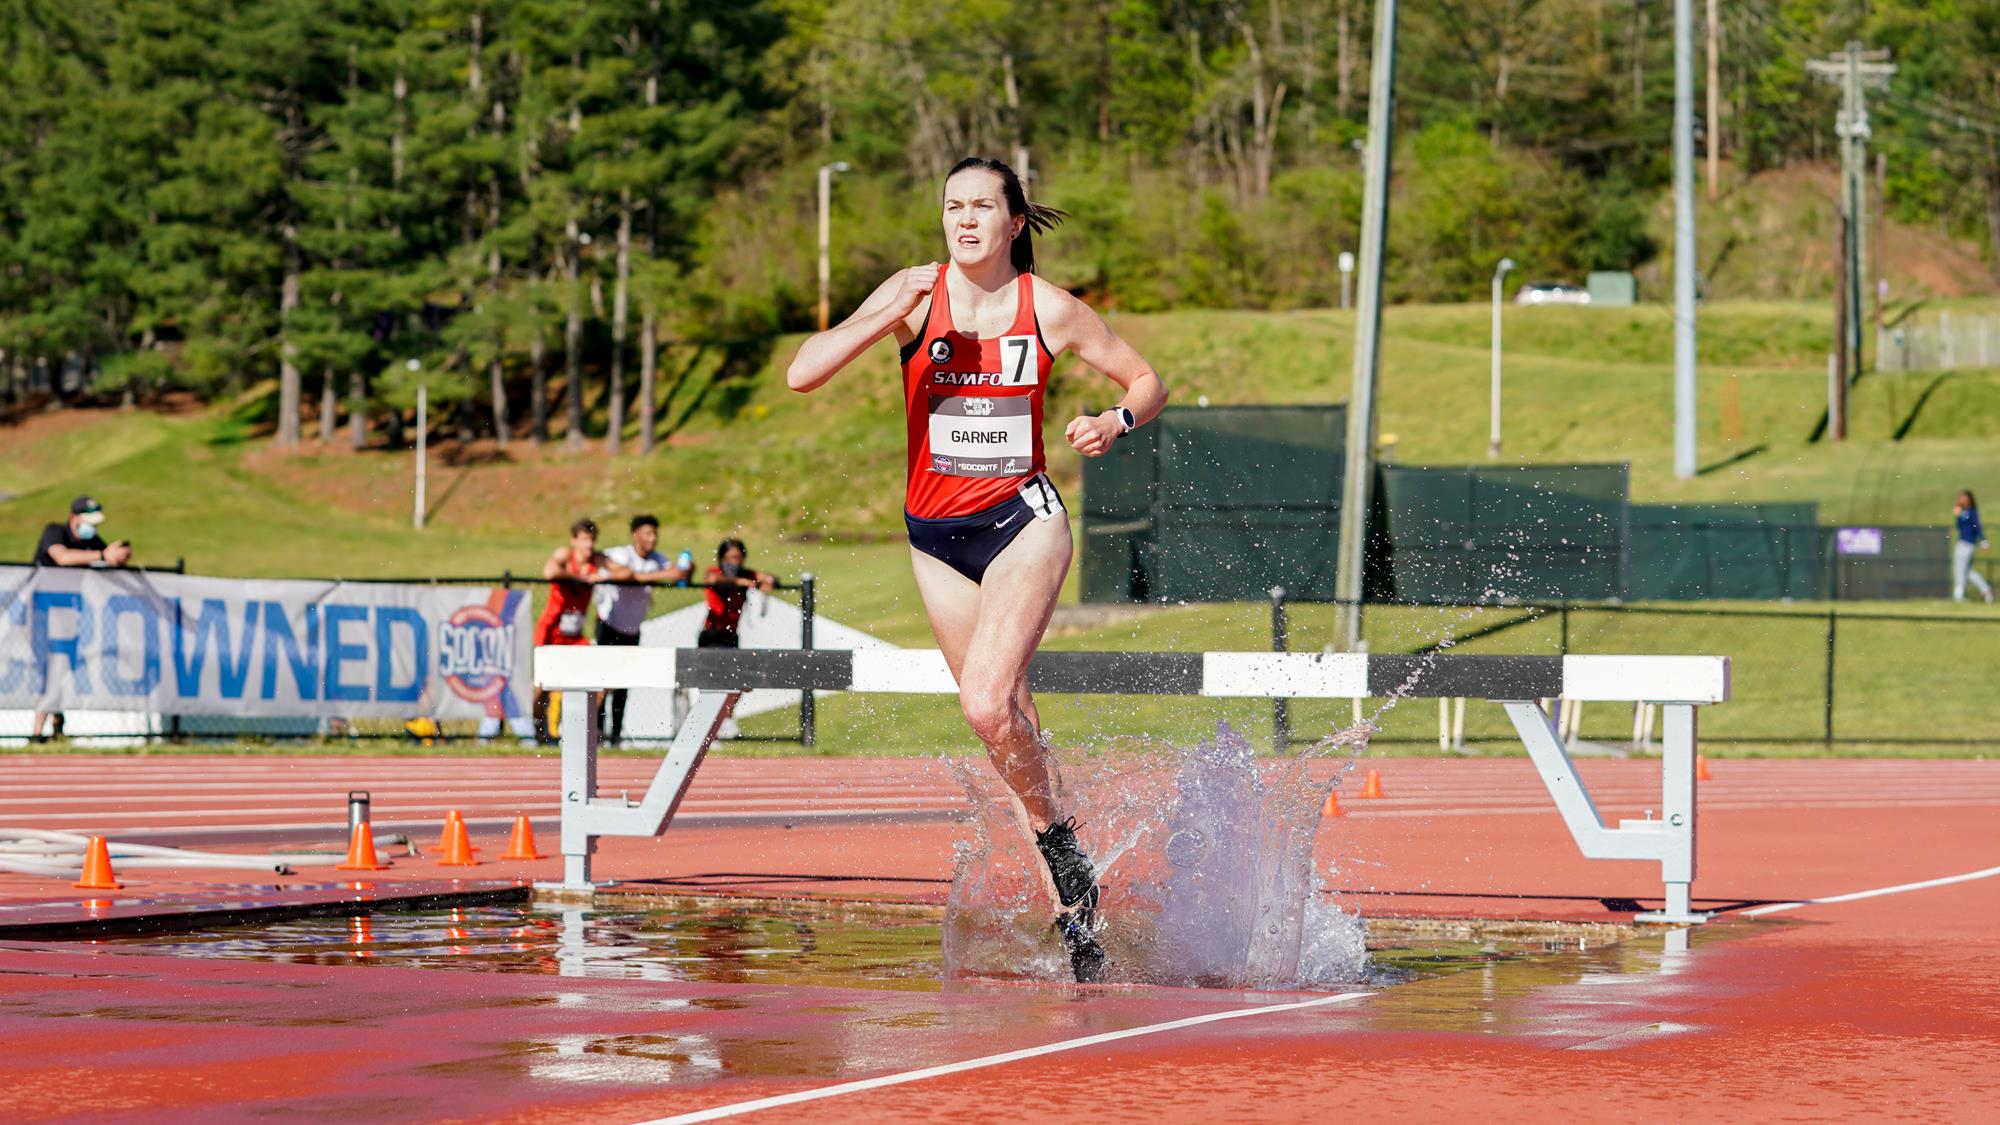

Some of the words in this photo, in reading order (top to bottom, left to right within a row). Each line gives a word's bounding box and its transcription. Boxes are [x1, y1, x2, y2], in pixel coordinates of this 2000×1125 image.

[1007, 338, 1029, 383] 7
[934, 371, 1004, 386] SAMFO
[951, 430, 1008, 444] GARNER
[1023, 474, 1052, 515] 7
